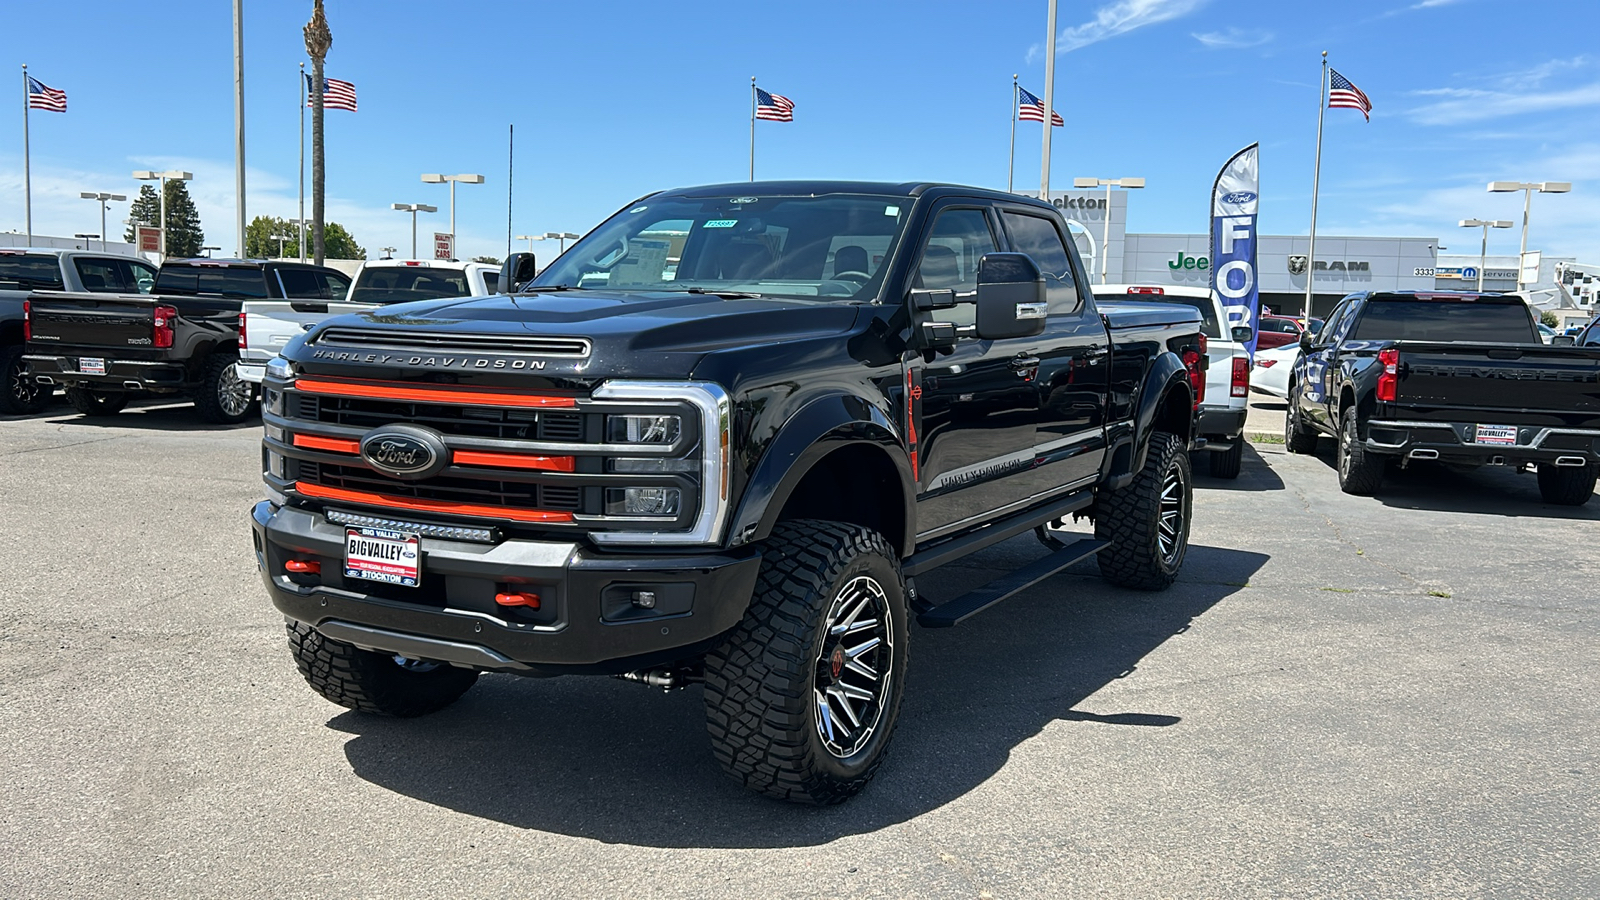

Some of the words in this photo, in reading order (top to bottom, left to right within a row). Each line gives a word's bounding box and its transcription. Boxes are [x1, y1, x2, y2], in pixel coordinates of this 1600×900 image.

[1024, 194, 1107, 209] ckton
[1227, 192, 1252, 203] Ford
[436, 249, 450, 258] CARS
[1168, 252, 1209, 270] Jee
[1216, 216, 1253, 328] FOR
[1313, 261, 1369, 271] RAM
[1414, 268, 1435, 276] 3333
[313, 349, 547, 371] HARLEY-DAVIDSON
[1413, 365, 1597, 383] CHEVROLET
[377, 440, 416, 465] Ford
[362, 528, 375, 536] BIG
[375, 530, 401, 539] VALLEY
[349, 539, 403, 561] BIGVALLEY
[361, 570, 402, 583] STOCKTON
